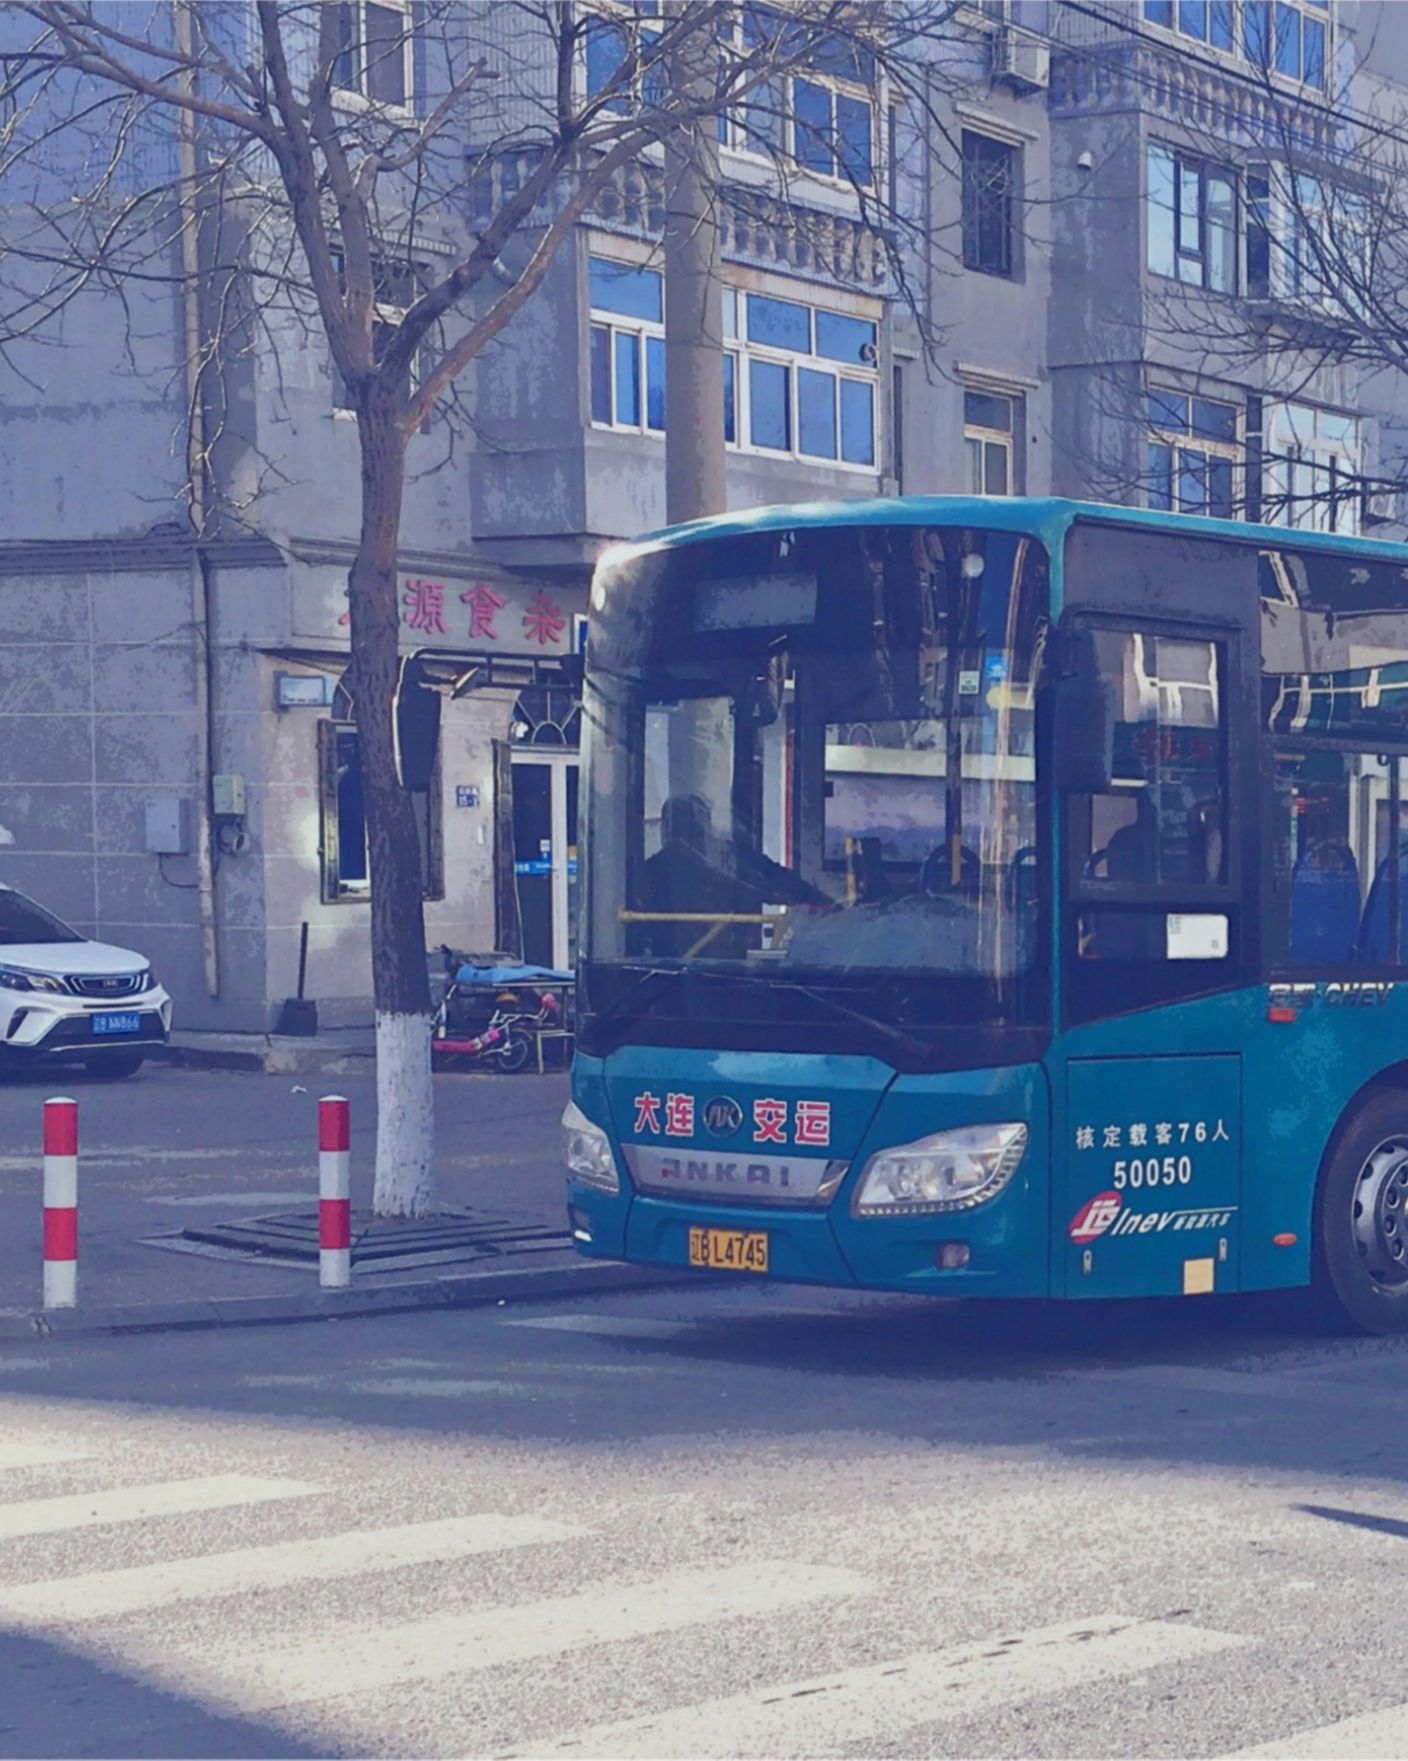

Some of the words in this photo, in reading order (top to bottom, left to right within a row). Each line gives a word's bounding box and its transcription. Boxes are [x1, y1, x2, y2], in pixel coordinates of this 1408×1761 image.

[633, 1090, 696, 1137] 大连
[752, 1097, 831, 1147] 交运
[660, 1157, 790, 1187] ANKAI
[1113, 1155, 1192, 1190] 50050
